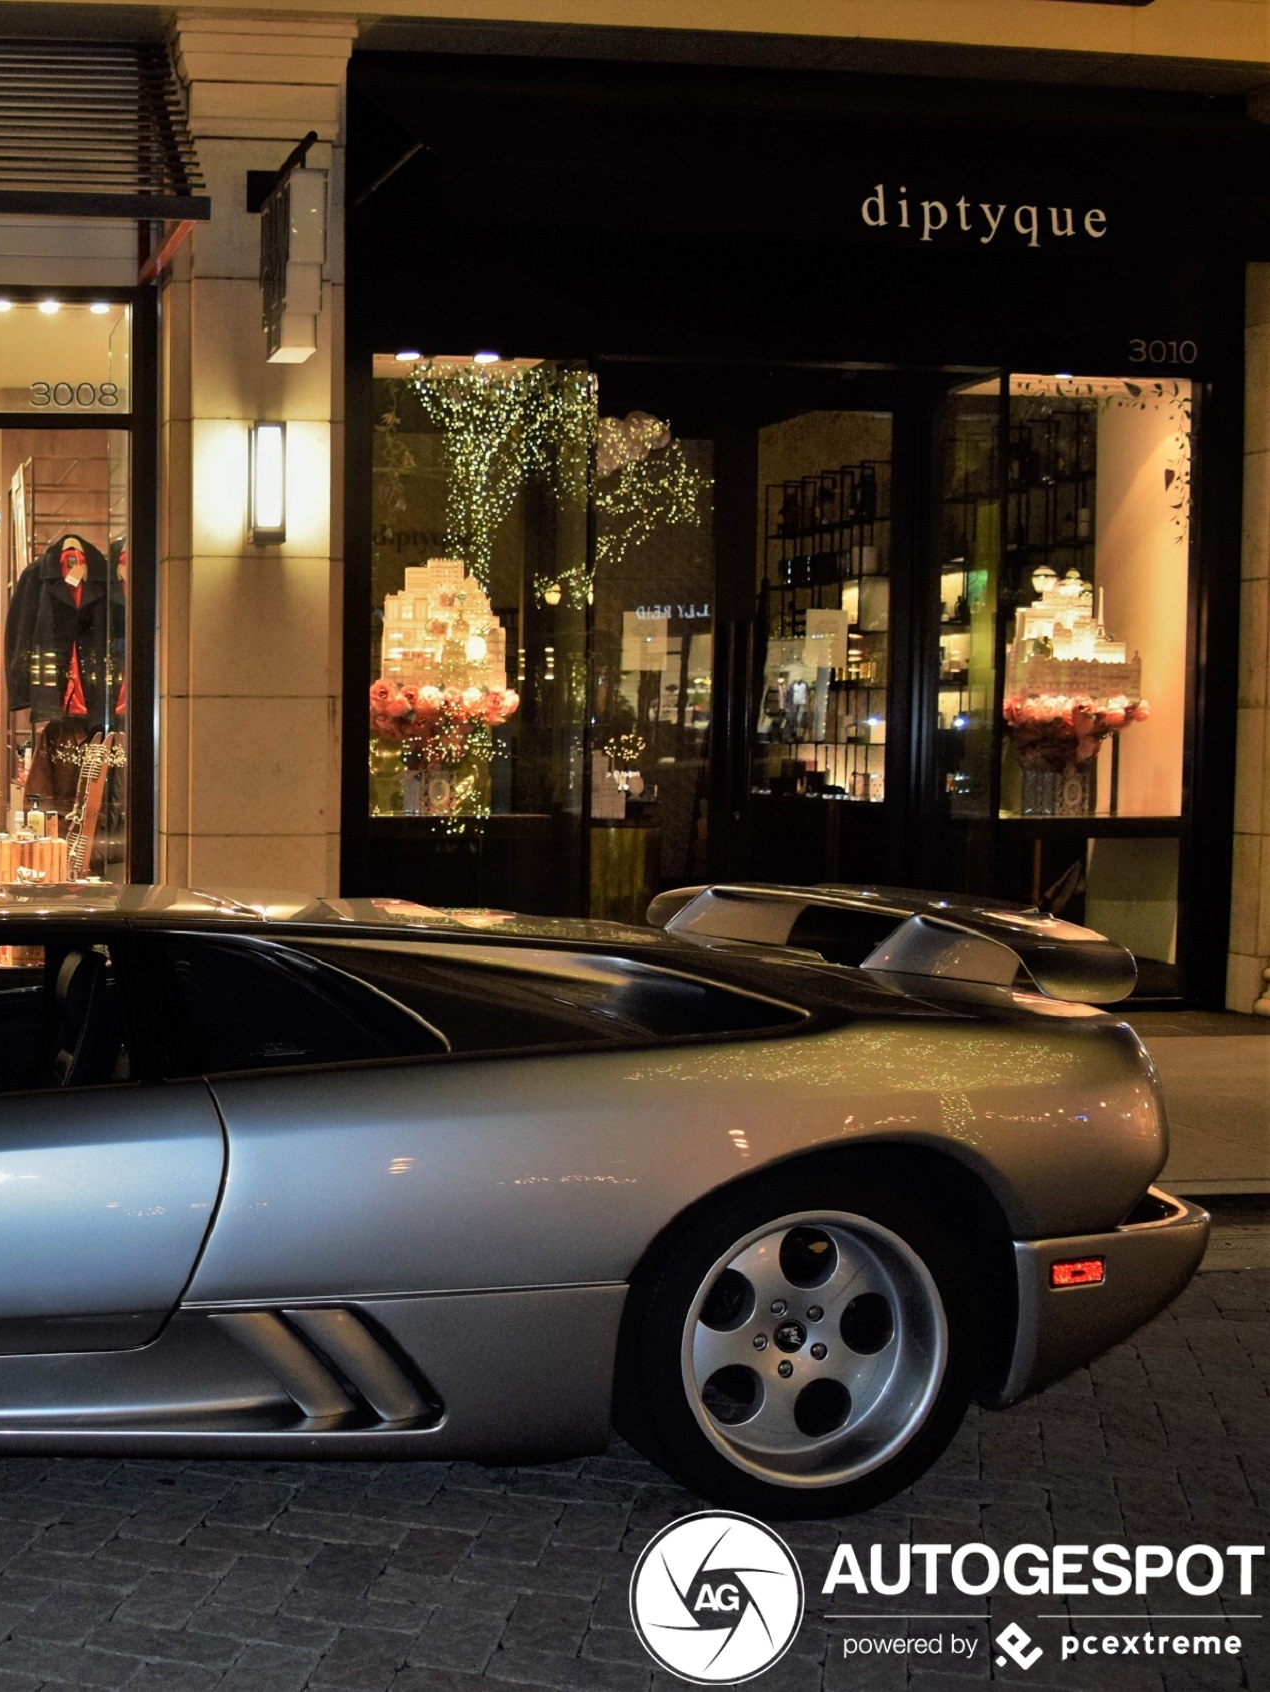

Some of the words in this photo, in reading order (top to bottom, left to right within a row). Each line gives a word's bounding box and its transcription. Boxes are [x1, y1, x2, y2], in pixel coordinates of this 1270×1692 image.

[861, 183, 1108, 247] diptyque
[1129, 338, 1198, 364] 3010
[31, 381, 119, 408] 3008
